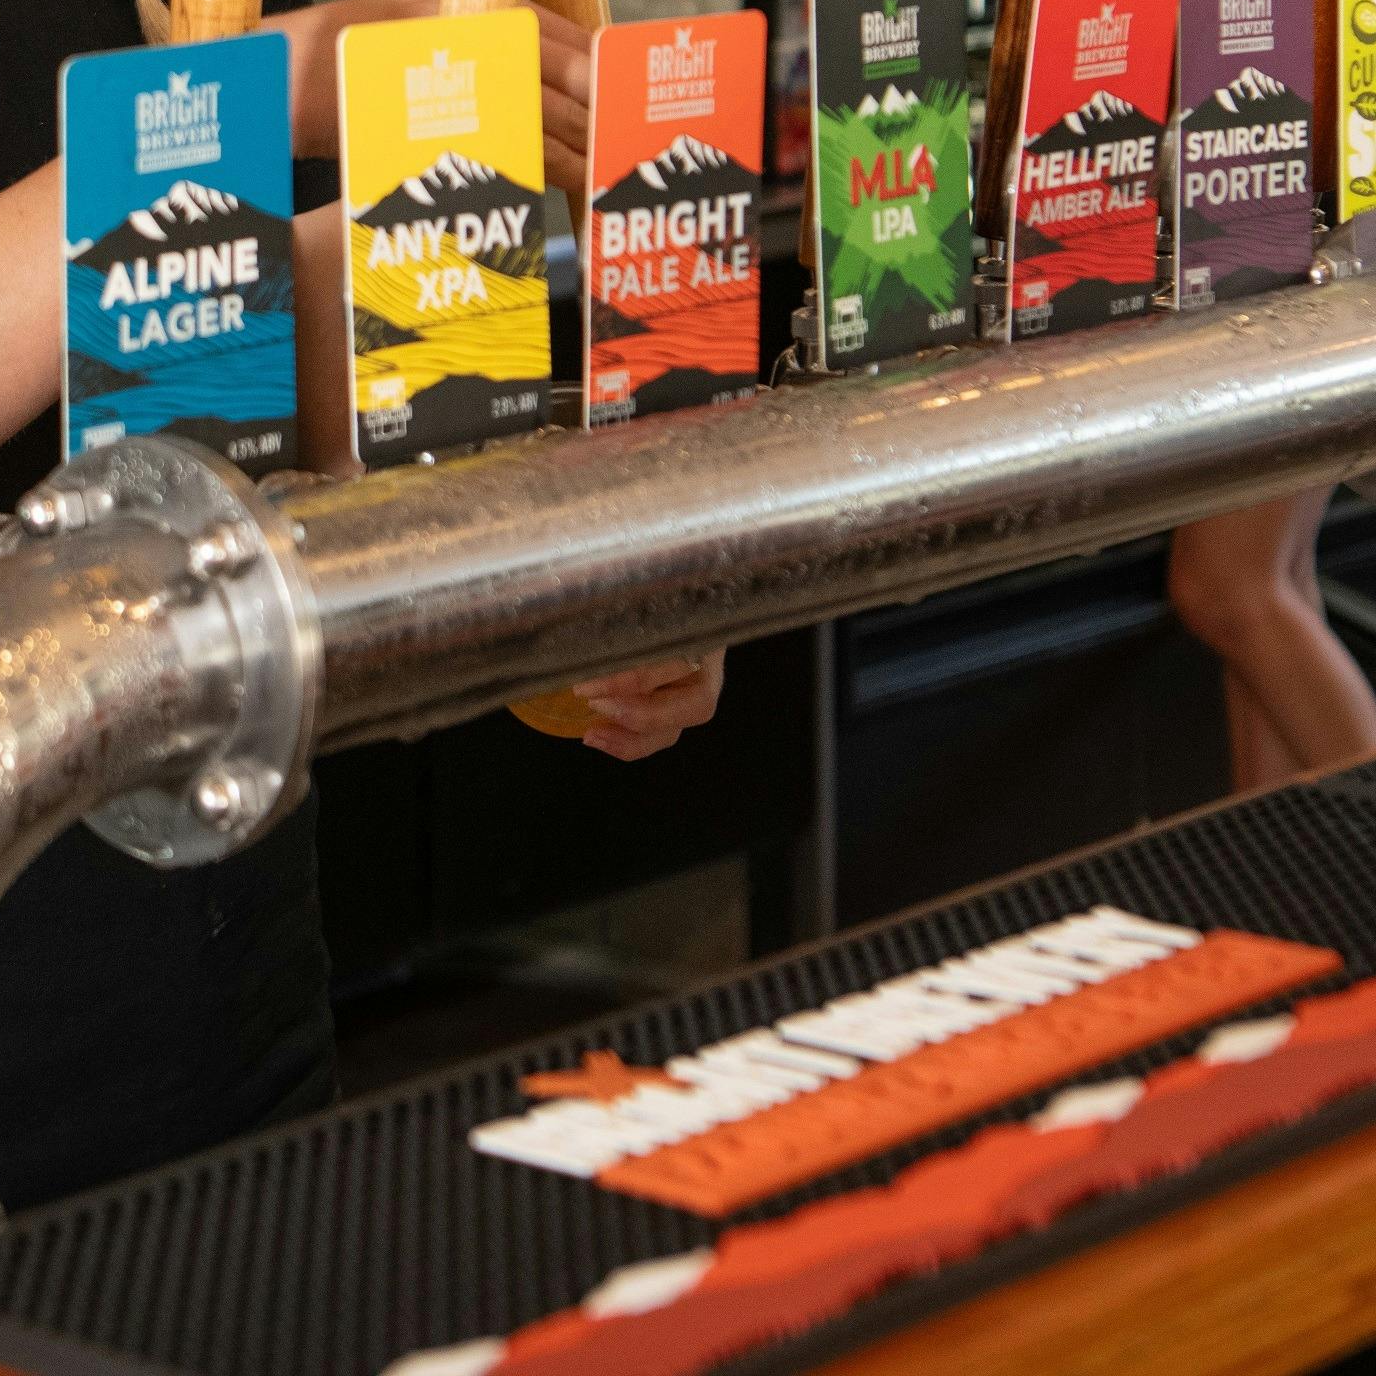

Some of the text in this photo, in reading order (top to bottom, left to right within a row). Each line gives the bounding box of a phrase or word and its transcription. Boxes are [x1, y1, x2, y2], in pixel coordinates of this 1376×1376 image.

[1024, 136, 1156, 193] HELLFIRE
[1184, 120, 1309, 162] STAIRCASE
[1027, 180, 1148, 228] AMBER ALE
[1184, 159, 1308, 209] PORTER
[368, 203, 531, 269] ANY DAY
[601, 193, 752, 261] BRIGHT
[100, 238, 259, 310] ALPINE
[416, 263, 489, 313] XPA
[600, 244, 751, 305] PALE ALE
[118, 293, 245, 353] LAGER
